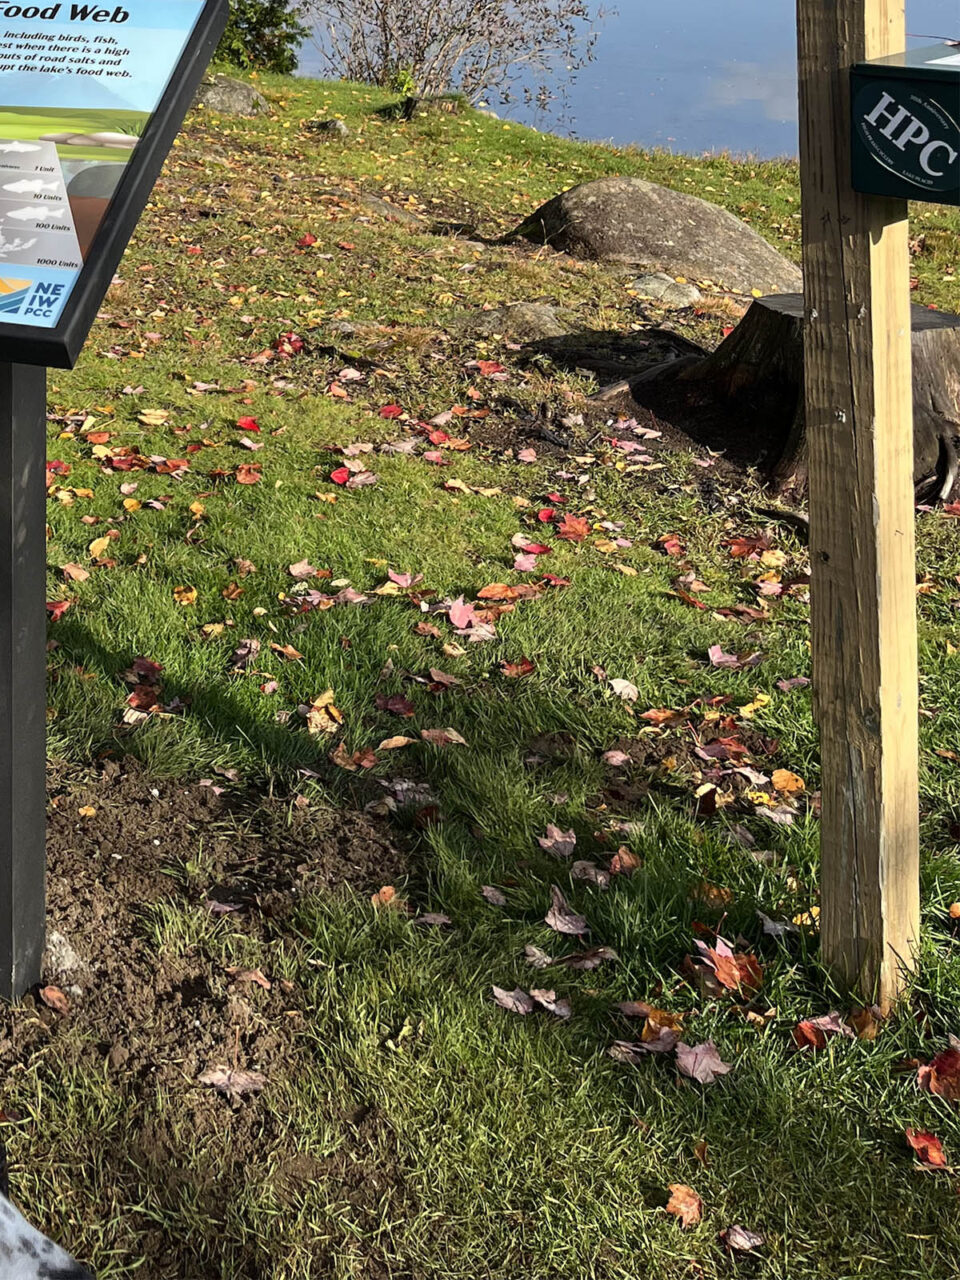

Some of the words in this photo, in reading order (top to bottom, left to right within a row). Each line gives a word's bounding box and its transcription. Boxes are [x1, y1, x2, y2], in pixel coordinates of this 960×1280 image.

[69, 3, 130, 24] Web
[3, 30, 56, 42] including
[57, 33, 90, 44] birds,
[93, 35, 119, 45] fish,
[15, 42, 46, 51] when
[47, 44, 80, 53] there
[81, 45, 92, 54] is
[103, 47, 130, 57] high
[23, 53, 38, 61] of
[38, 55, 67, 63] road
[68, 56, 96, 65] salts
[98, 58, 122, 66] and
[17, 63, 38, 72] the
[75, 67, 104, 76] food
[106, 70, 133, 78] web.
[863, 90, 958, 177] HPC
[35, 222, 51, 230] 100
[50, 223, 71, 231] Units
[36, 258, 58, 266] 1000
[58, 260, 79, 268] Units
[34, 281, 66, 297] NE
[28, 294, 60, 309] IW
[23, 307, 53, 318] PCC
